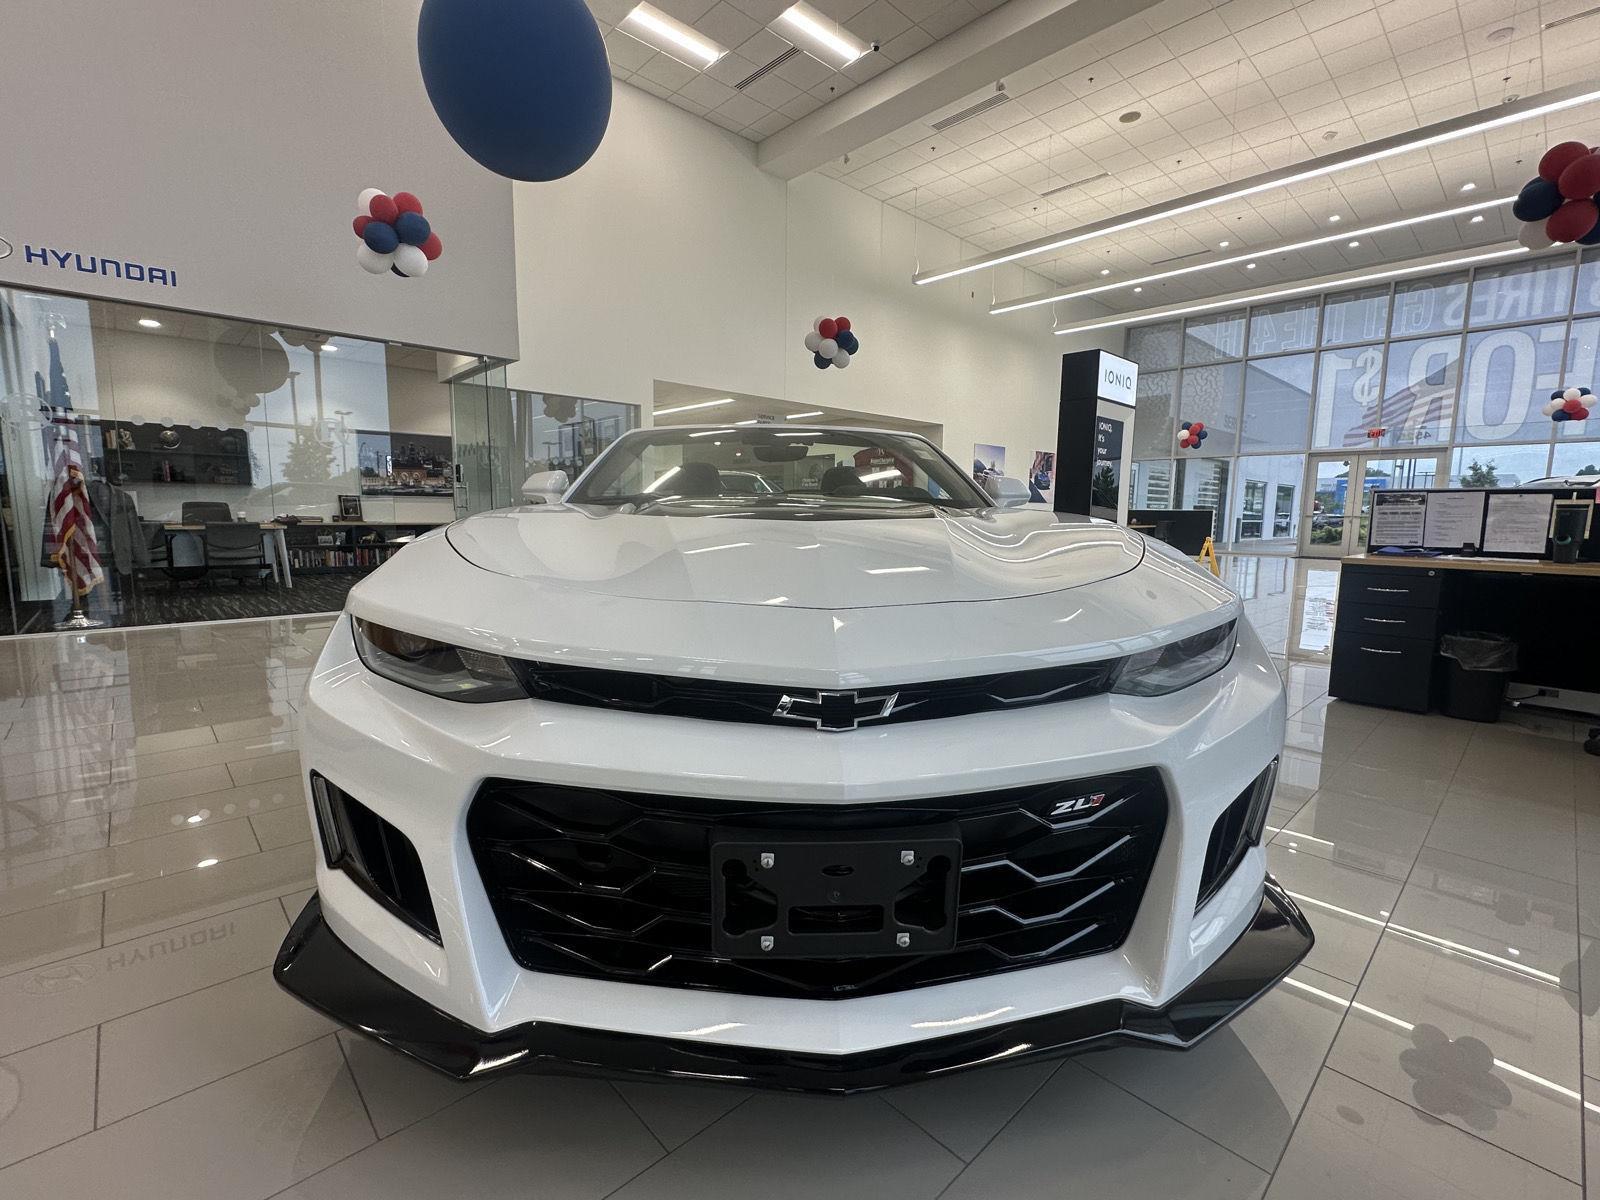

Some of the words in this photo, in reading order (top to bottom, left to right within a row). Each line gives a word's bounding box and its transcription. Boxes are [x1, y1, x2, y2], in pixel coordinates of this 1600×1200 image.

[25, 245, 177, 287] HYUNDAI
[1104, 368, 1132, 389] IONIQ
[1050, 793, 1106, 815] ZL1
